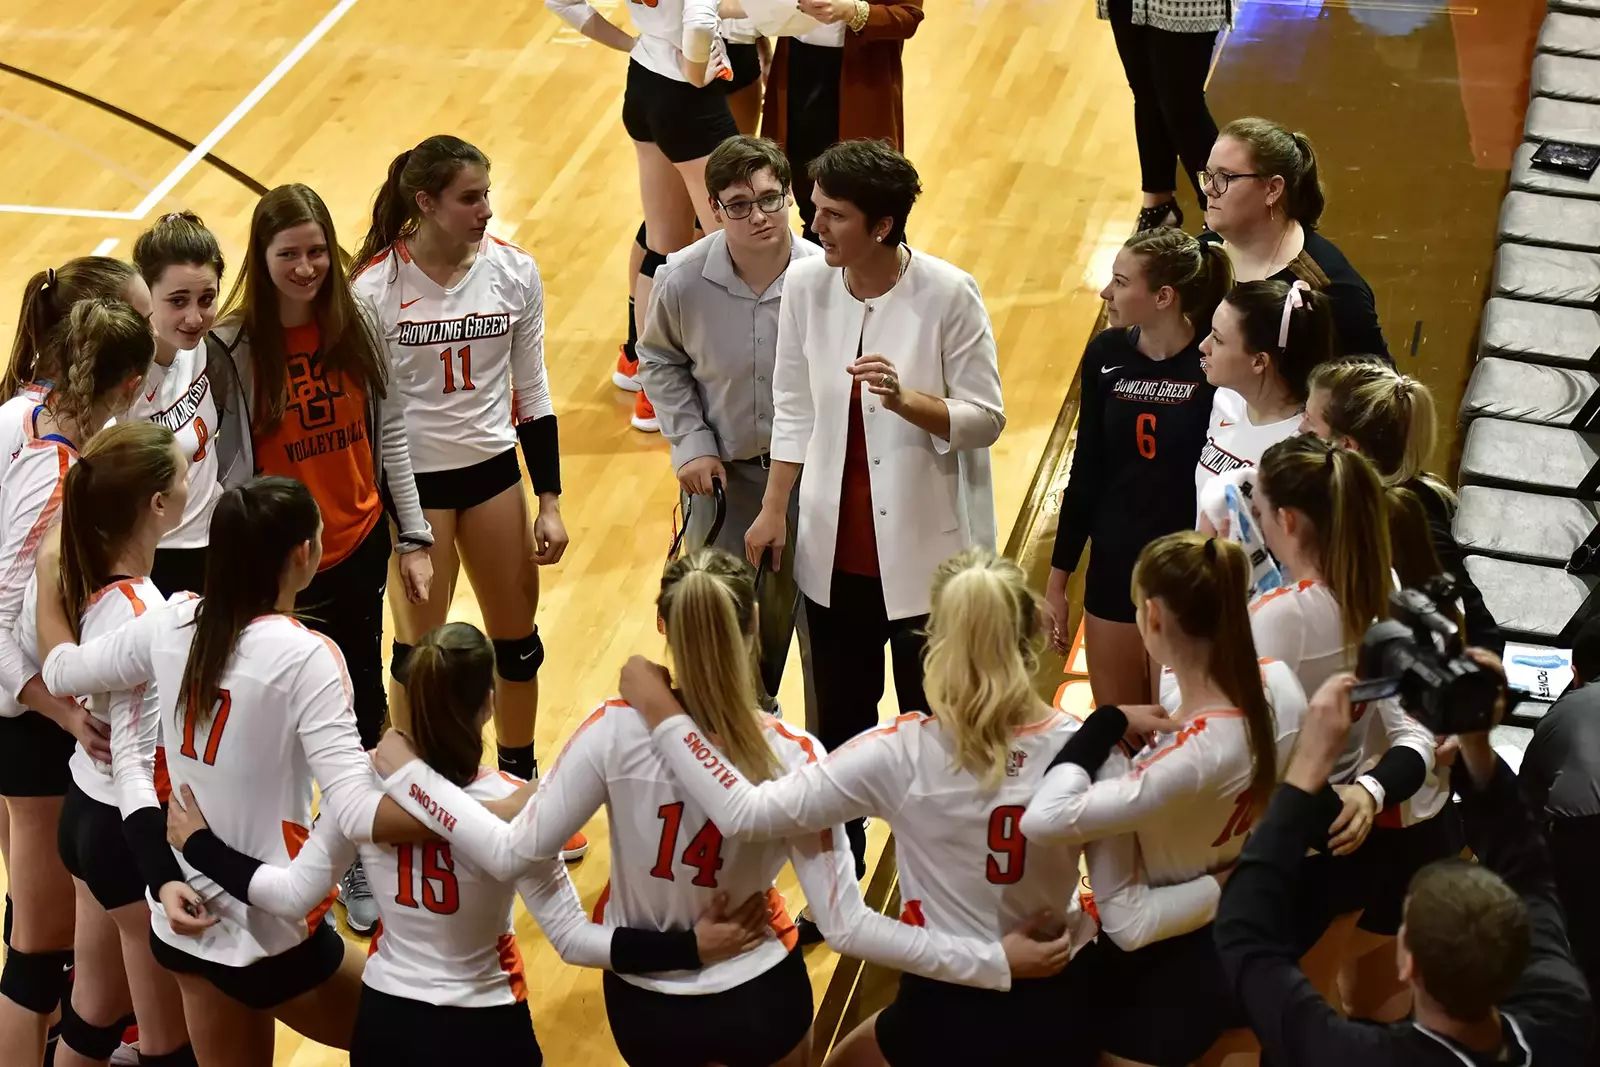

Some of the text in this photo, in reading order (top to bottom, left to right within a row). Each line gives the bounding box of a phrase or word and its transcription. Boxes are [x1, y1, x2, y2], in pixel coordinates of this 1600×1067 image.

[400, 315, 508, 344] BOWLING GREEN
[440, 345, 476, 394] 11
[1113, 378, 1195, 399] BOWLING GREEN
[1122, 393, 1175, 403] VOLLEYBALL
[284, 420, 364, 464] VOLLEYBALL
[1136, 413, 1157, 460] 6
[683, 731, 738, 790] FALCONS
[408, 783, 458, 832] FALCONS
[650, 801, 724, 888] 14
[986, 805, 1027, 884] 9
